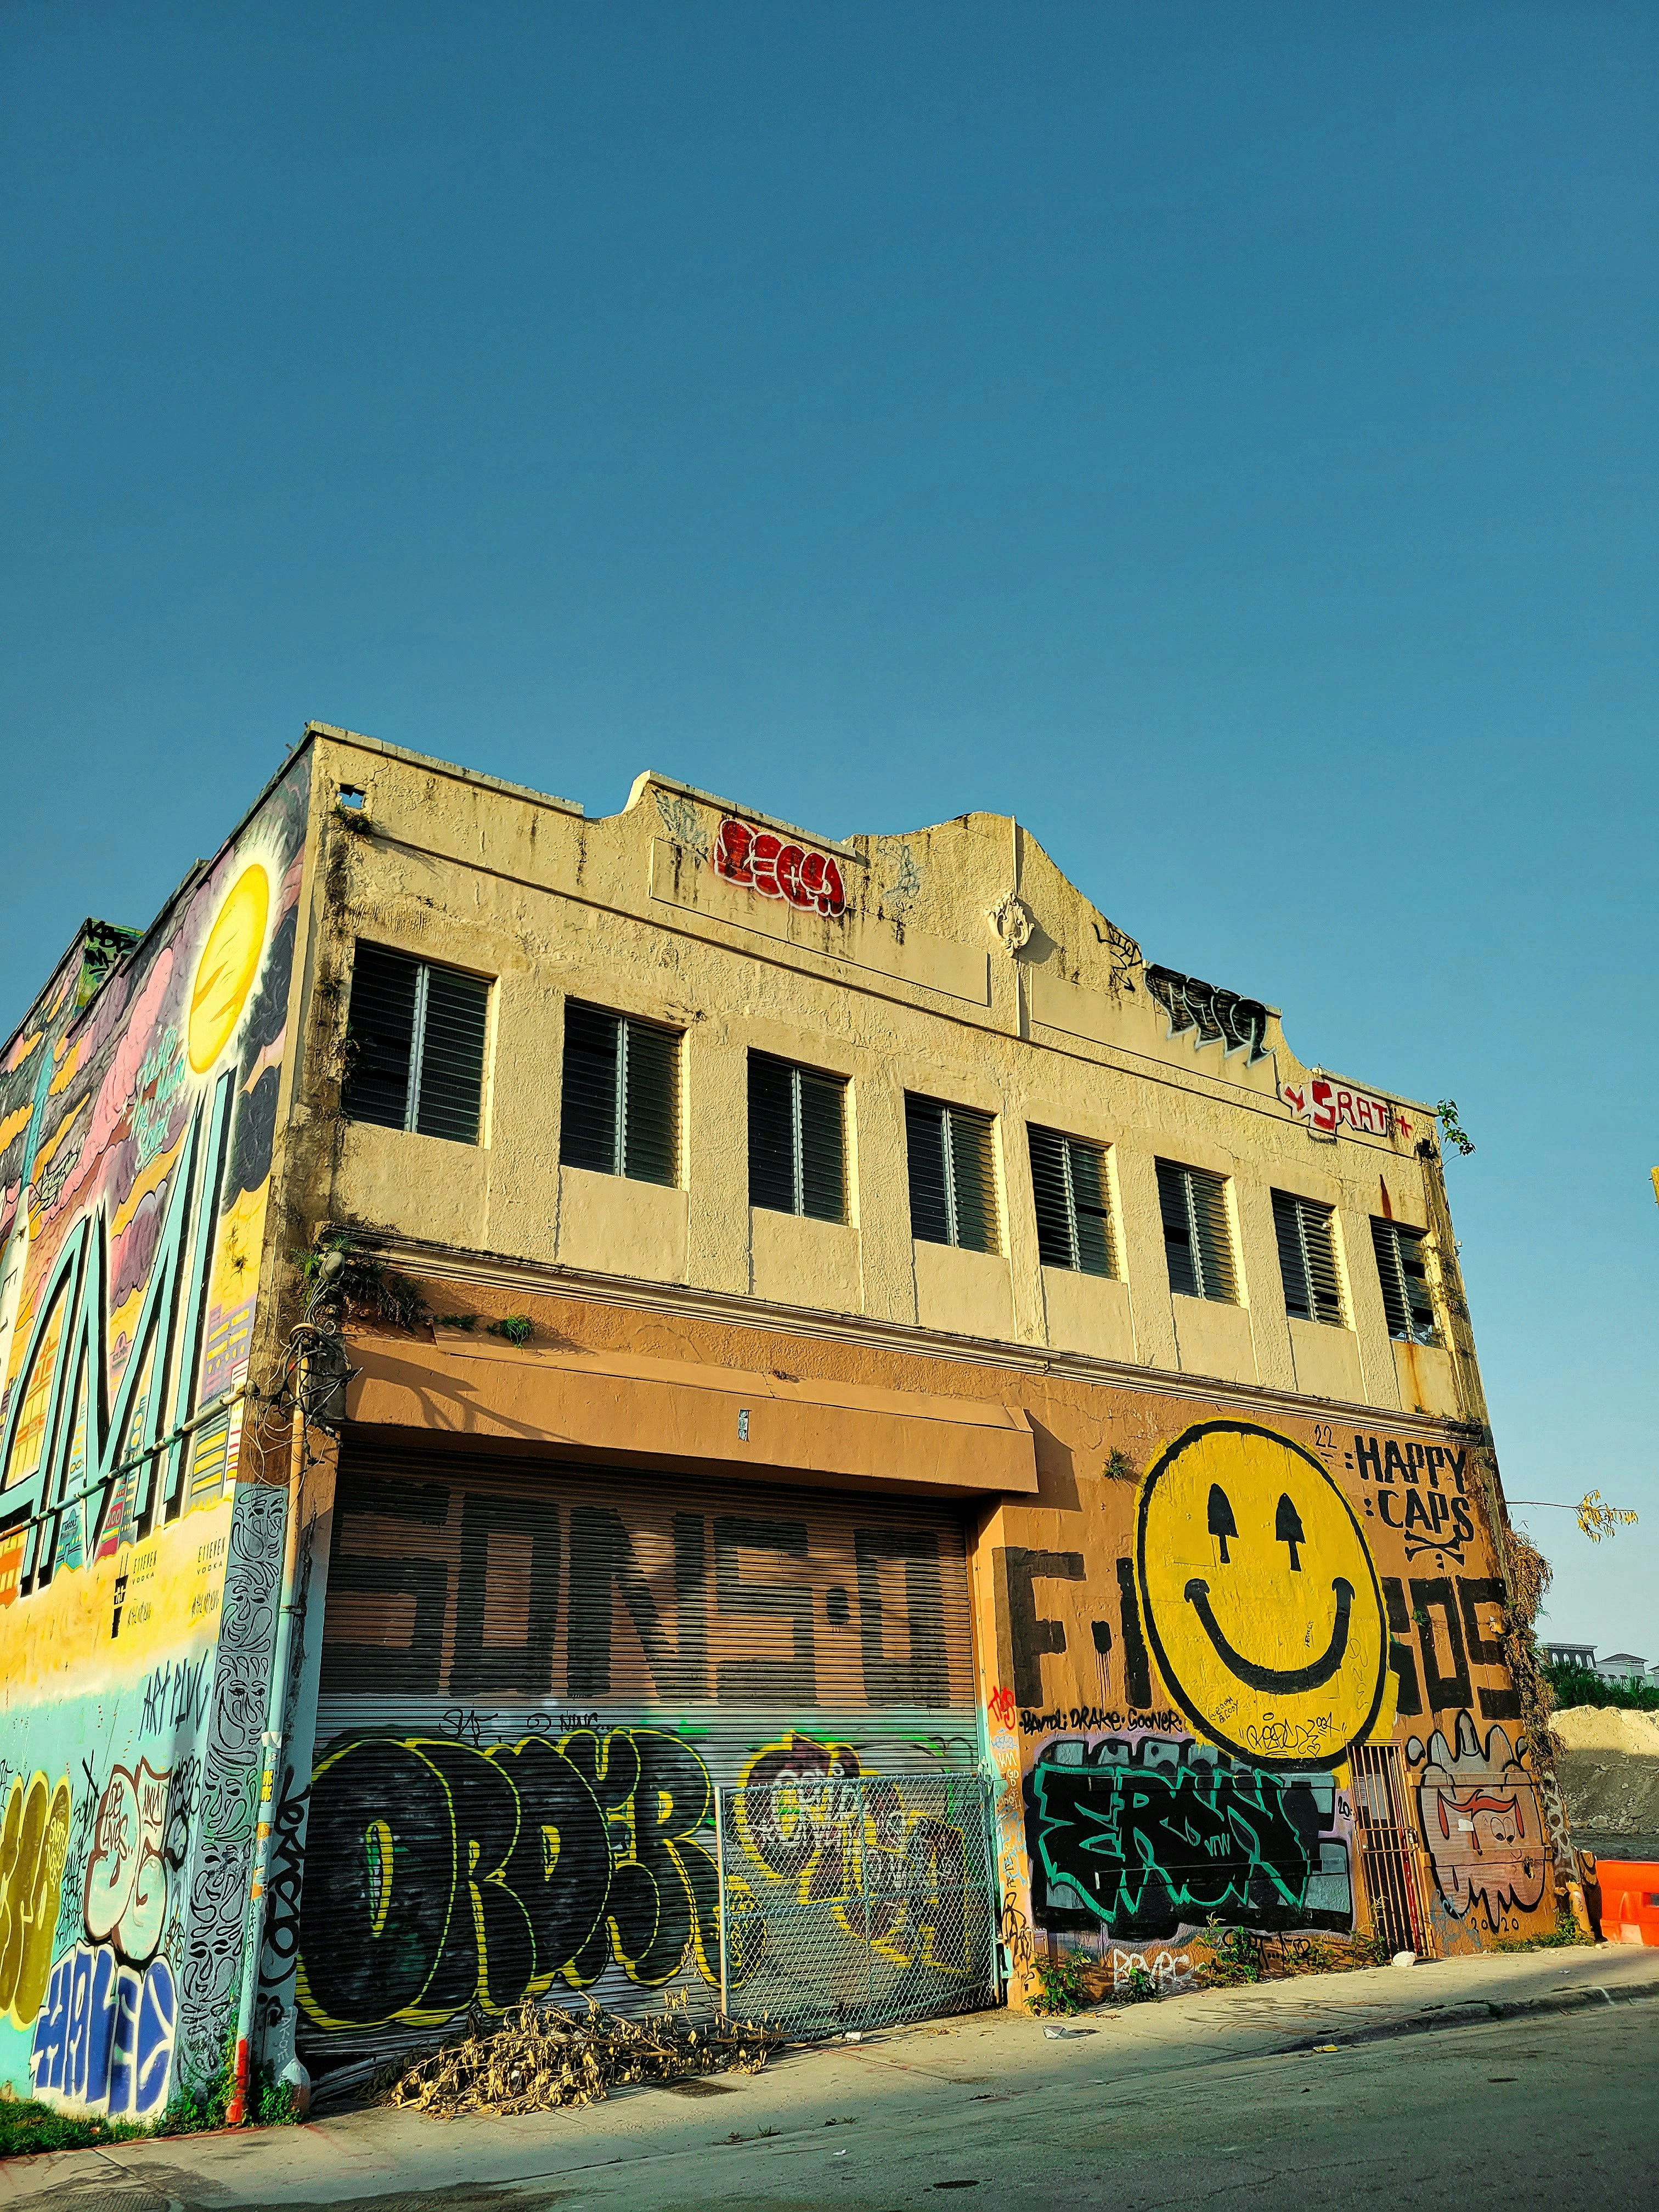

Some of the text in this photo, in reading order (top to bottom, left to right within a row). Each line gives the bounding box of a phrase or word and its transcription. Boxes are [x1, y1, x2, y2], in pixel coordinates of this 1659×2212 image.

[1355, 1435, 1466, 1494] HAPPY
[1378, 1488, 1474, 1542] CAPS
[197, 1561, 223, 1575] VODKA
